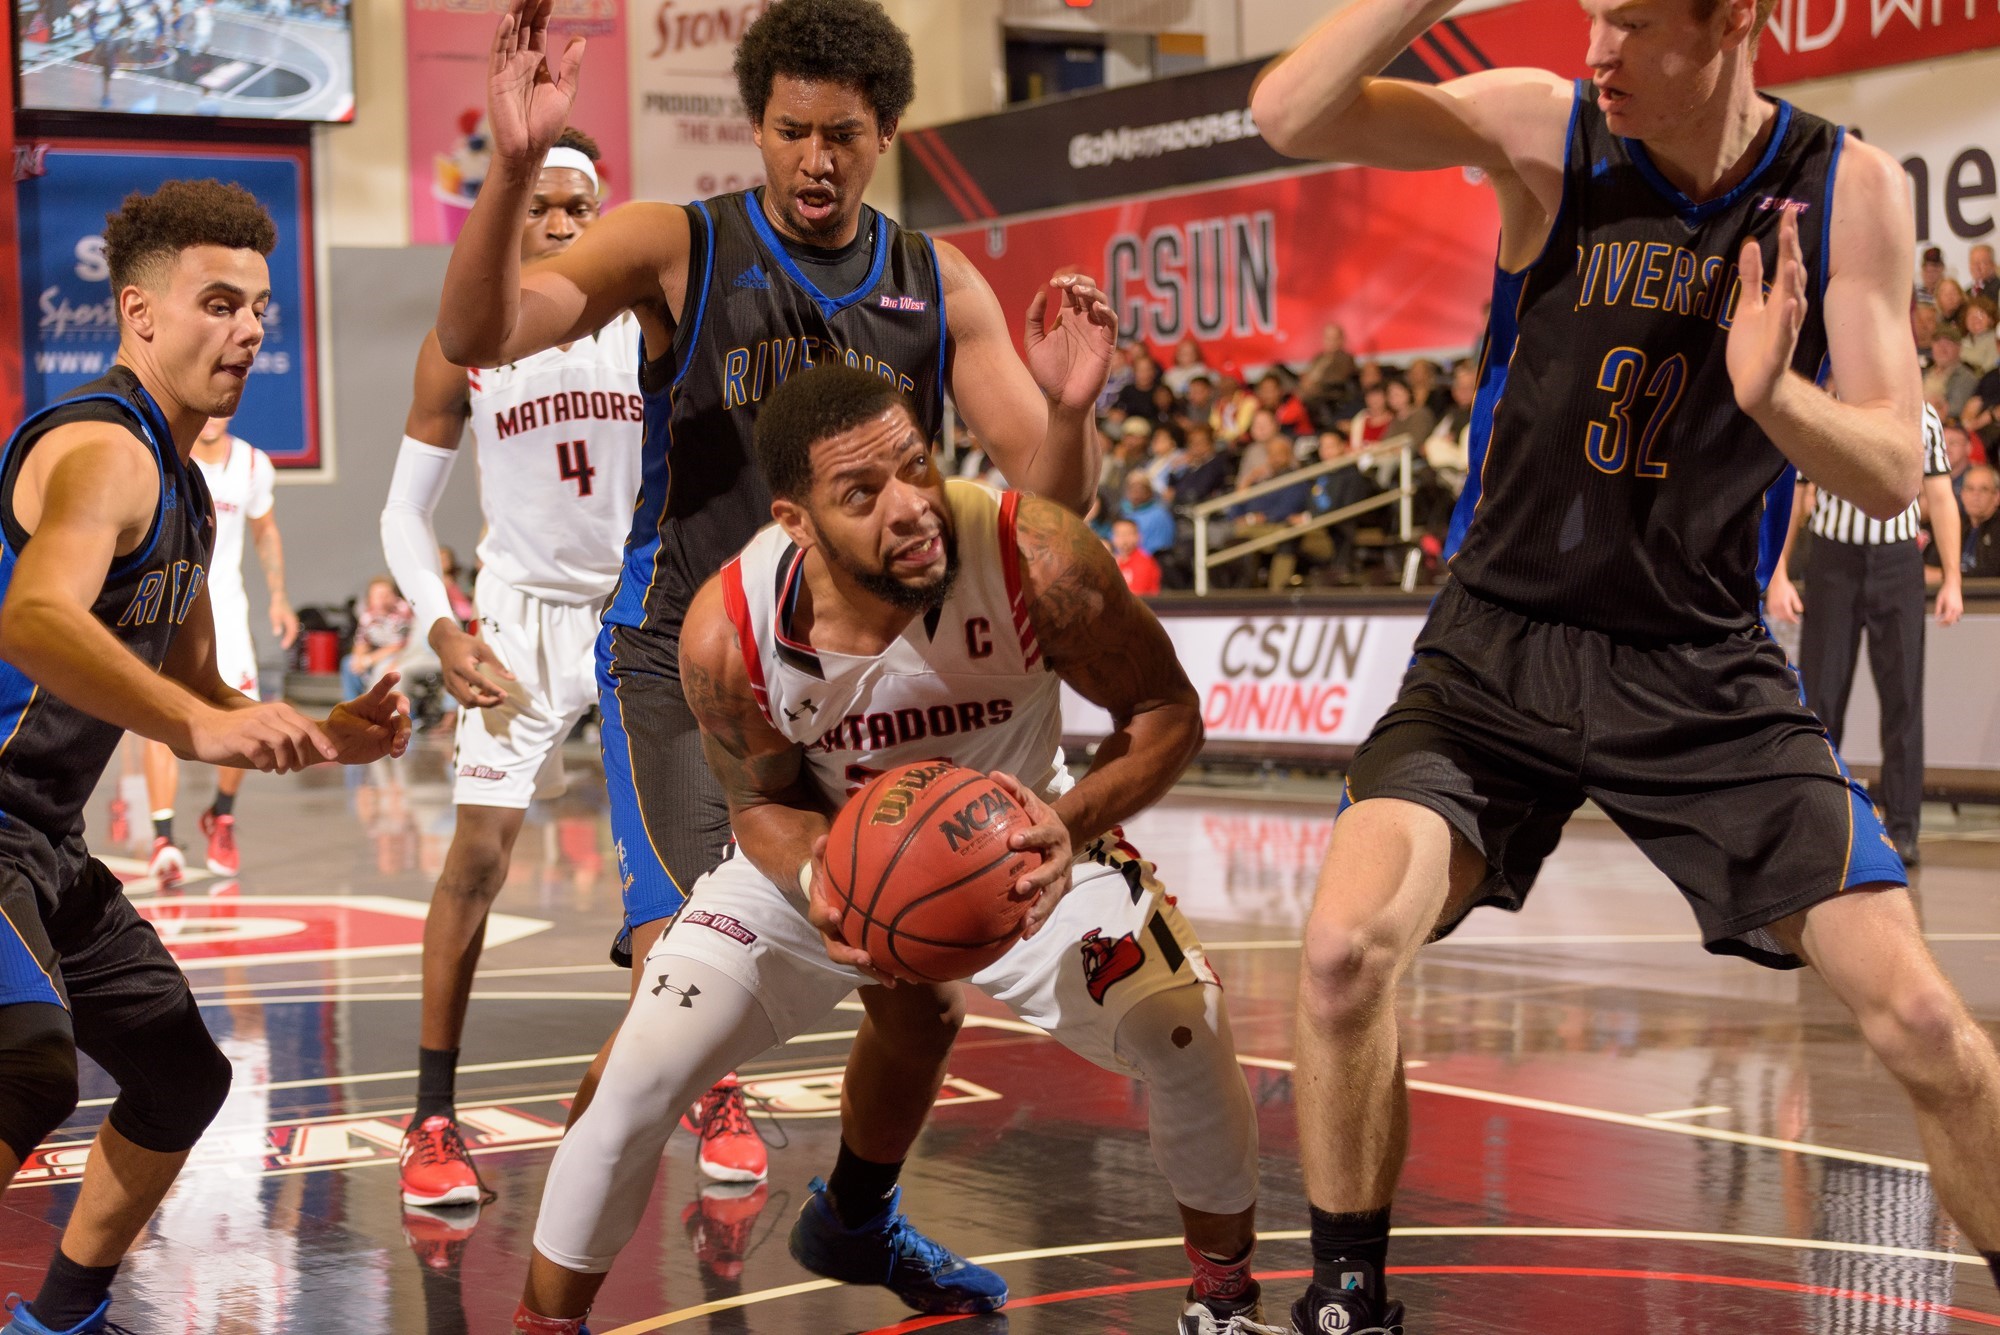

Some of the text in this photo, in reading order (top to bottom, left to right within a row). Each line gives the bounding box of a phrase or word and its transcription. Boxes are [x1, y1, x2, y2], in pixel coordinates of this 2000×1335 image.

[879, 295, 926, 311] BIG WEST
[1104, 211, 1278, 348] CSUN
[496, 391, 644, 440] MATADORS
[1585, 346, 1688, 479] 32
[556, 440, 596, 497] 4
[964, 616, 993, 660] C
[1221, 617, 1370, 680] CSUN
[1204, 682, 1348, 734] DINING
[939, 788, 1016, 853] NCAA
[684, 910, 757, 945] BIG WEST
